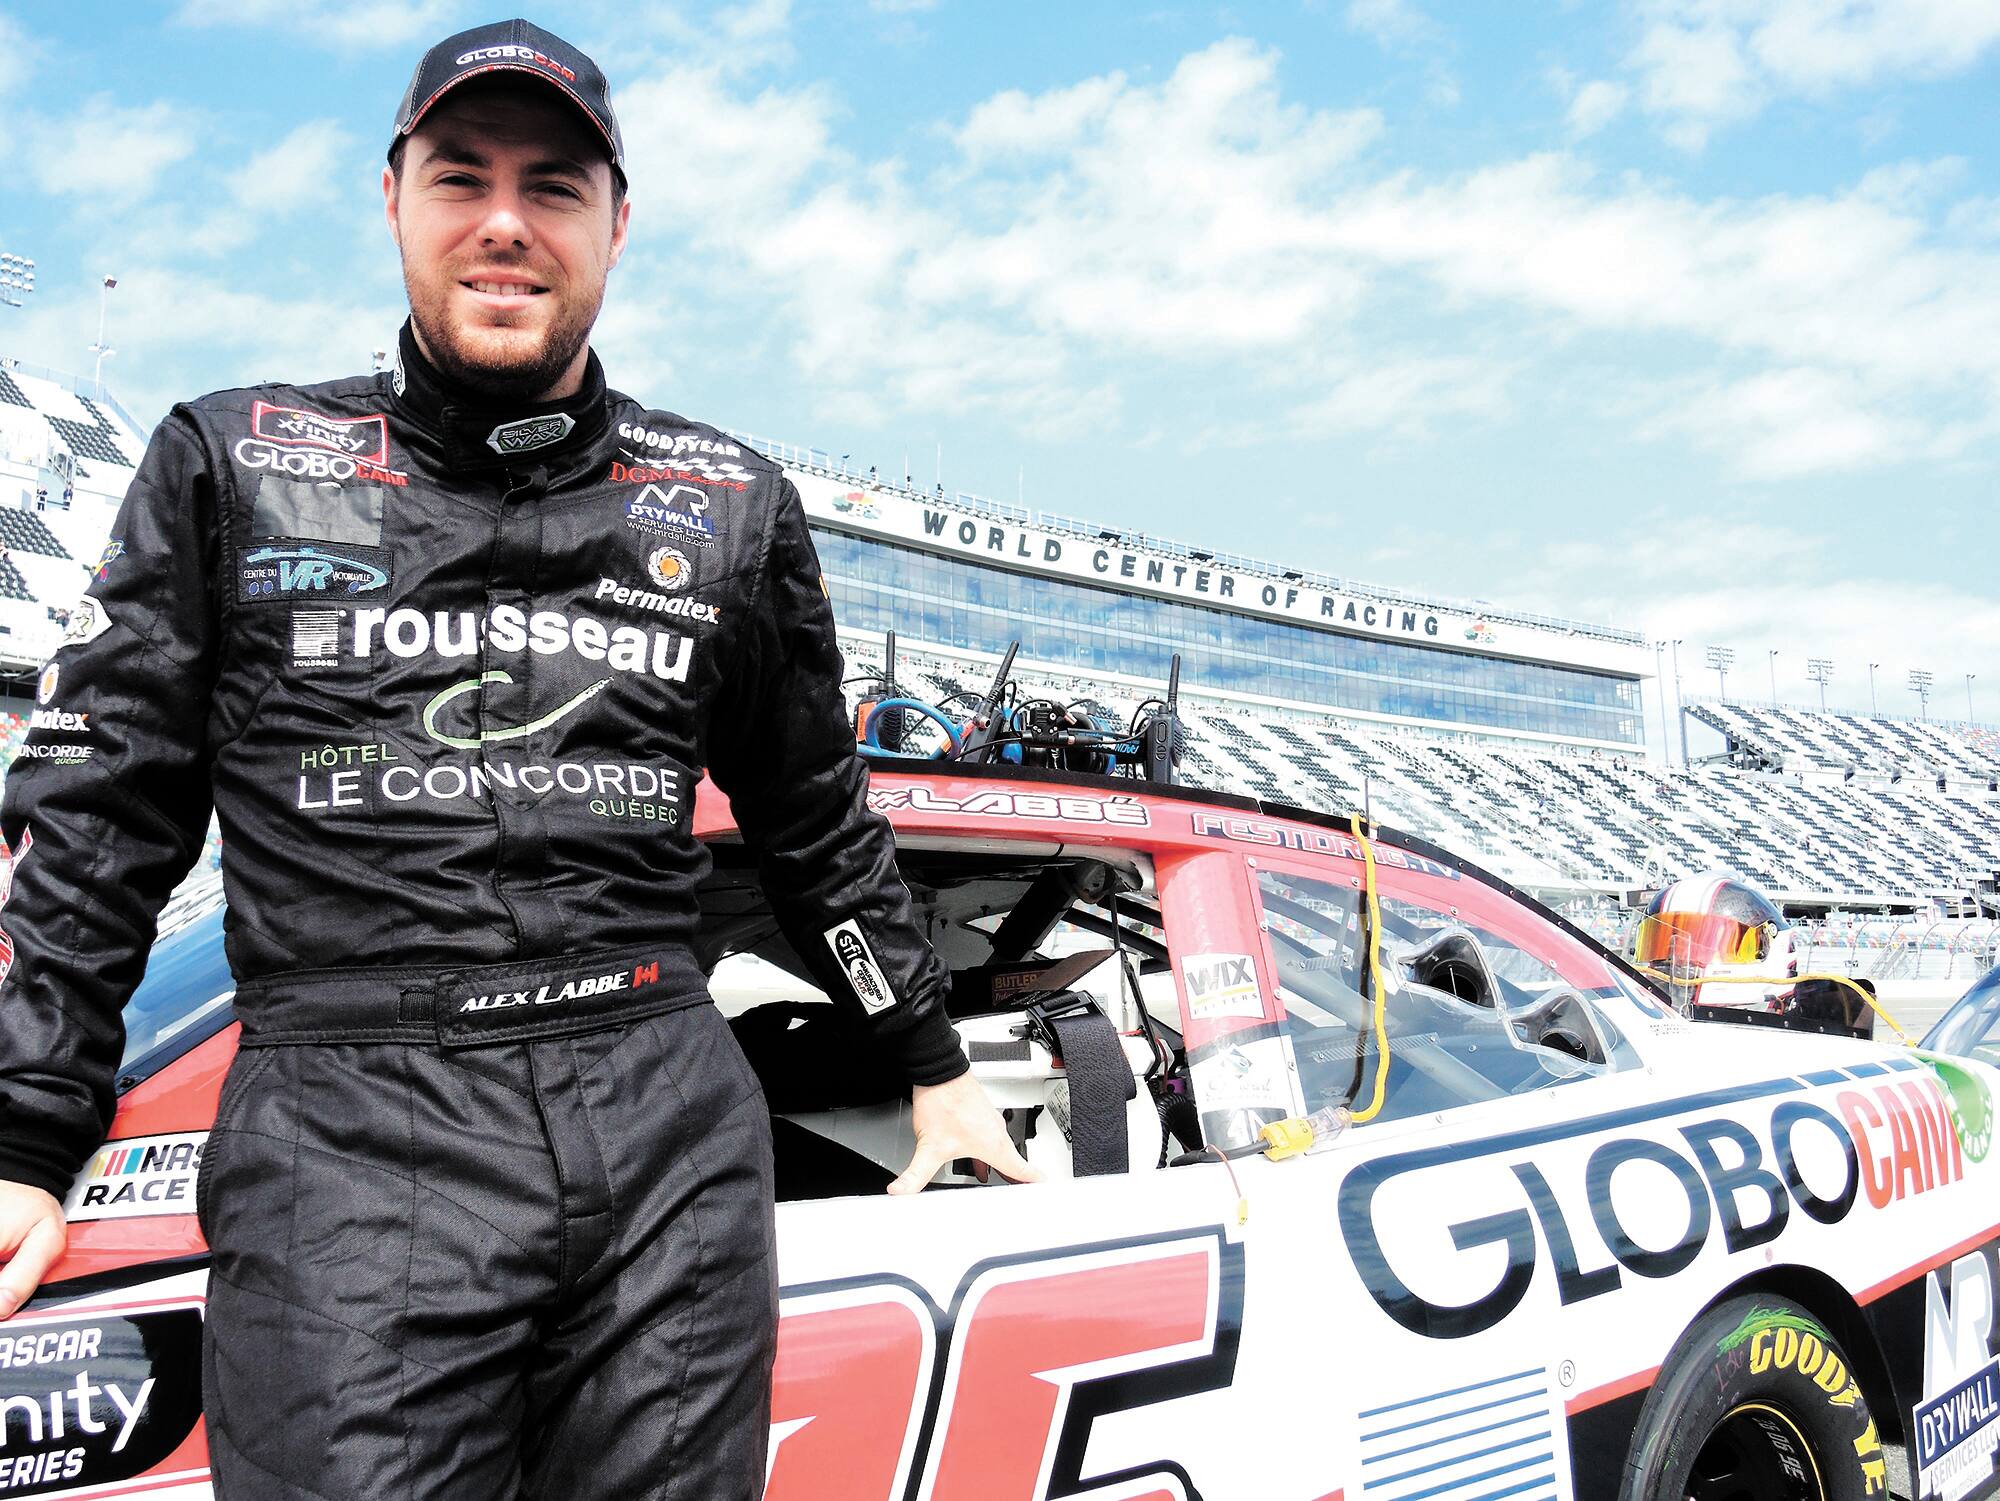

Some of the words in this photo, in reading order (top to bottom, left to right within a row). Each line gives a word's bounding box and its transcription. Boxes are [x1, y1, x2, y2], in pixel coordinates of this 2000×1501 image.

[456, 46, 577, 82] GLOBOCAM
[502, 420, 562, 440] SILVER
[504, 429, 562, 449] WAX
[618, 422, 741, 458] GOODYEAR
[235, 438, 409, 487] GLOBOCAM
[609, 461, 674, 484] DGM
[630, 504, 708, 532] DRYWALL
[639, 517, 684, 534] SERVICES
[685, 528, 704, 541] LLC
[243, 569, 267, 580] CENTRE
[267, 568, 278, 578] DU
[280, 560, 334, 591] VR
[923, 509, 1062, 562] WORLD
[1092, 549, 1236, 598] CENTER
[1261, 585, 1299, 609] OF
[1321, 597, 1440, 636] RACING
[595, 577, 720, 625] Permatex
[354, 604, 695, 682] rousseau
[293, 659, 339, 668] rousseau
[30, 707, 91, 732] atex
[301, 744, 398, 771] HÔTEL
[297, 769, 364, 810] LE
[381, 762, 680, 804] CONCORDE
[589, 799, 679, 825] QUÉBEC
[907, 787, 1150, 827] LABBÉ
[839, 934, 862, 960] sfi
[459, 990, 531, 1012] ALEX
[534, 971, 630, 1006] LABBE
[995, 974, 1038, 989] BUTLER
[1186, 957, 1253, 996] WIX
[82, 1177, 190, 1207] RACE
[1921, 1375, 1998, 1460] DRYWALL
[1933, 1436, 1978, 1490] SERVICES
[1979, 1424, 1996, 1454] LLC
